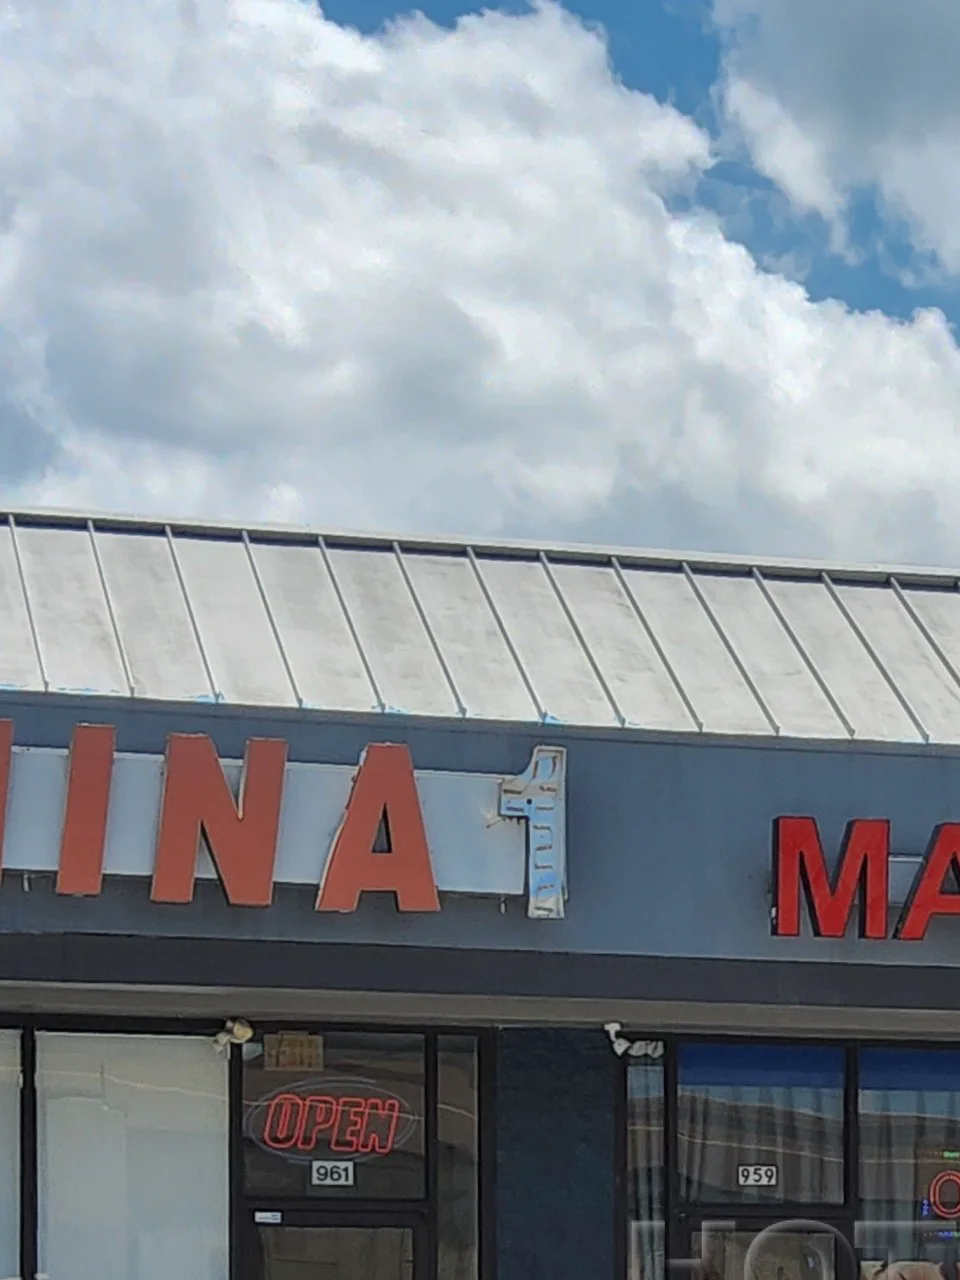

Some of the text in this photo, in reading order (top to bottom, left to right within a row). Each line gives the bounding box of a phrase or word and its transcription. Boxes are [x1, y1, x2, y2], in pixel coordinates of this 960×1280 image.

[0, 718, 442, 912] INA
[264, 1094, 400, 1155] OPEN
[316, 1165, 350, 1182] 961
[741, 1167, 774, 1183] 959
